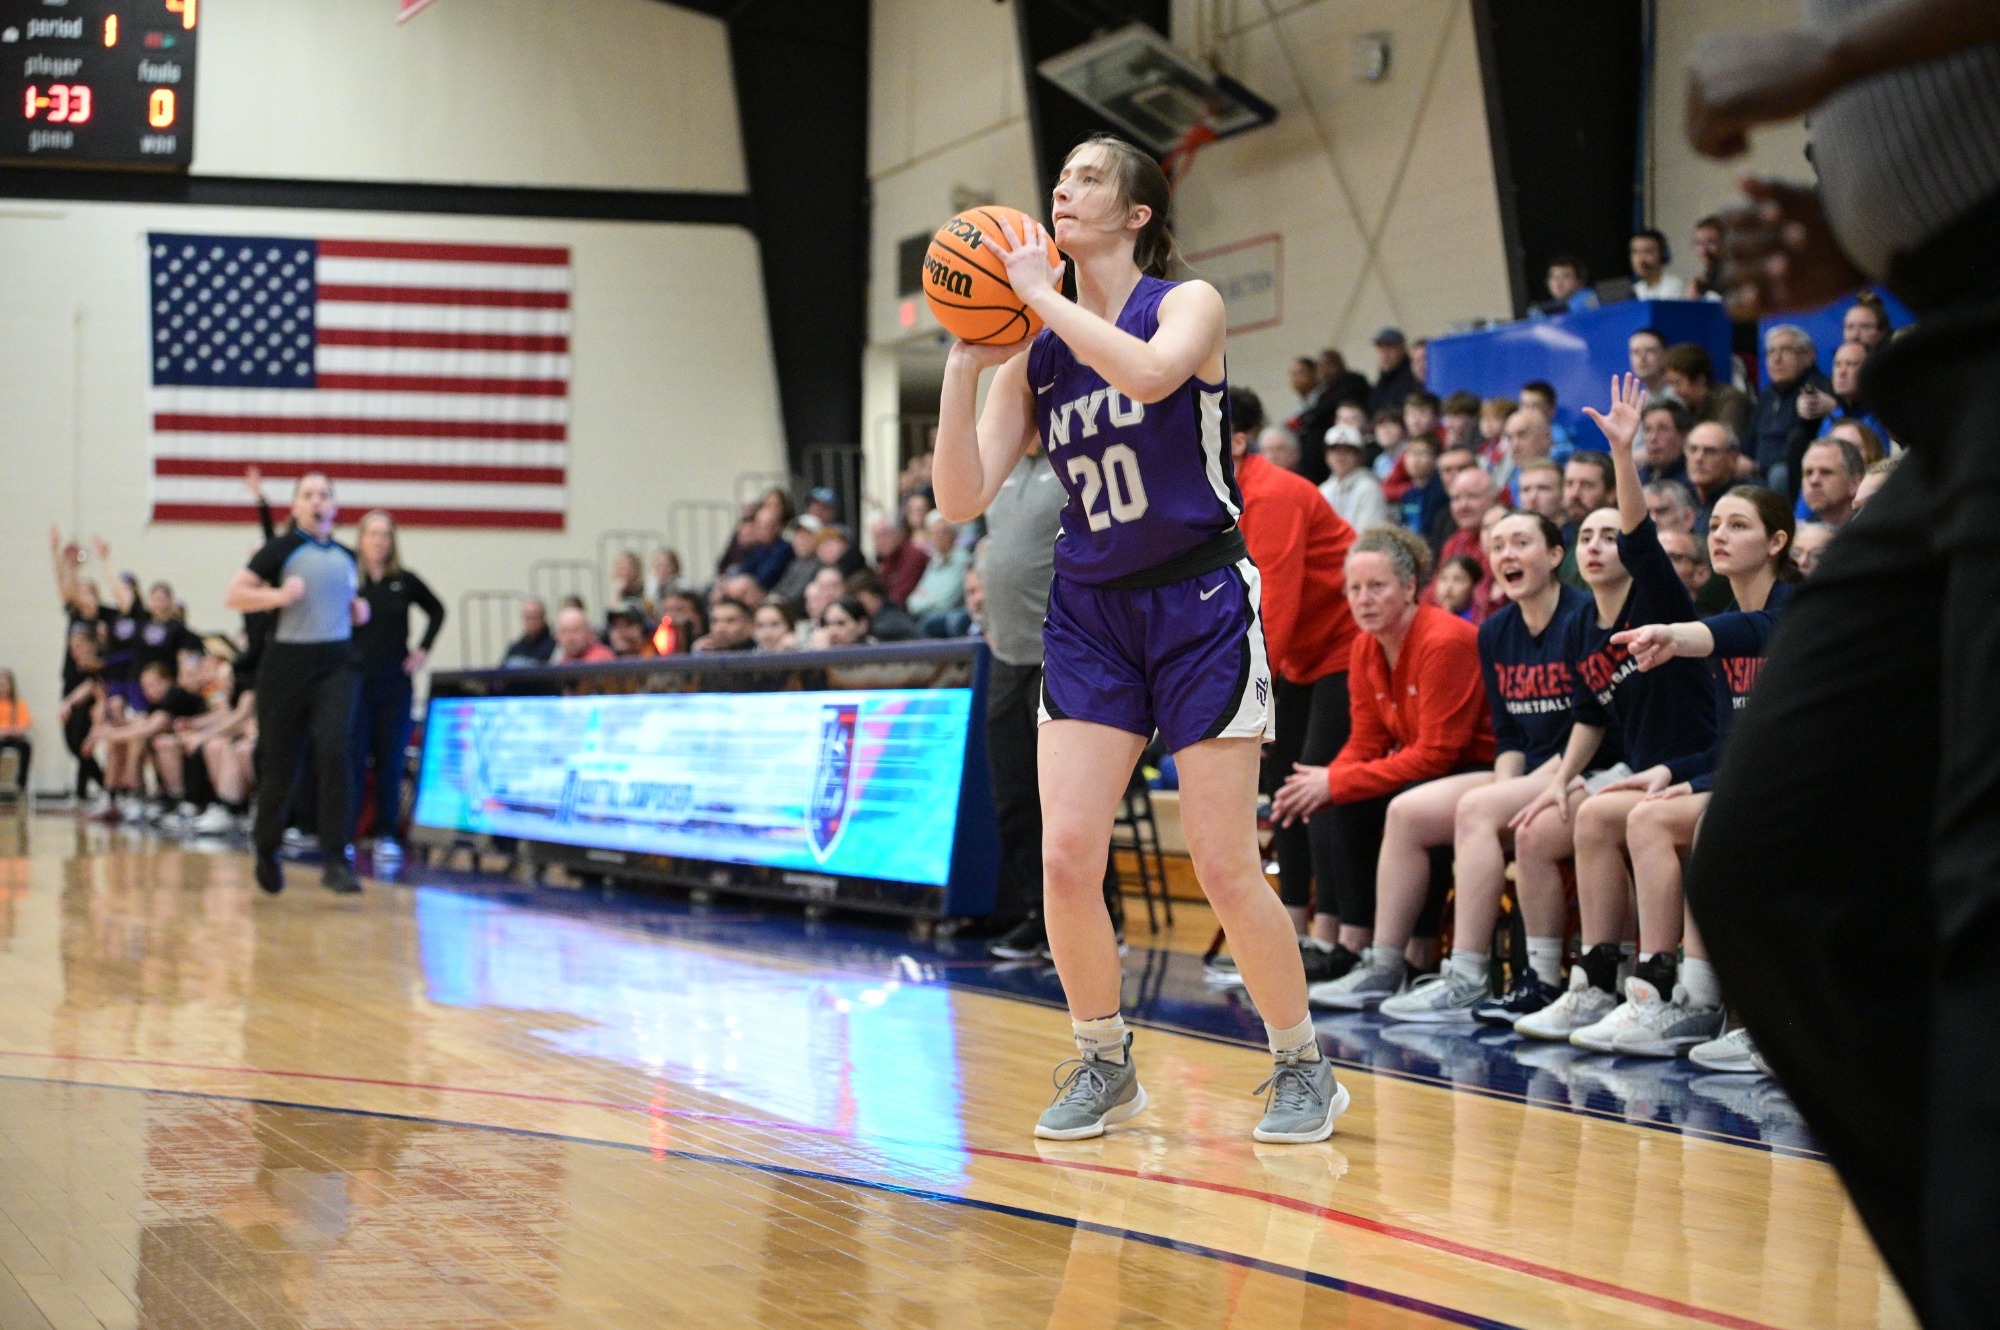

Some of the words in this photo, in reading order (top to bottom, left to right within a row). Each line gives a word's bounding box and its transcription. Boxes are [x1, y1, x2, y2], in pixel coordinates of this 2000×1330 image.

[26, 16, 83, 40] period
[149, 88, 175, 127] 0
[943, 218, 983, 250] NCA
[1048, 386, 1146, 452] NYU
[1066, 443, 1149, 532] 20
